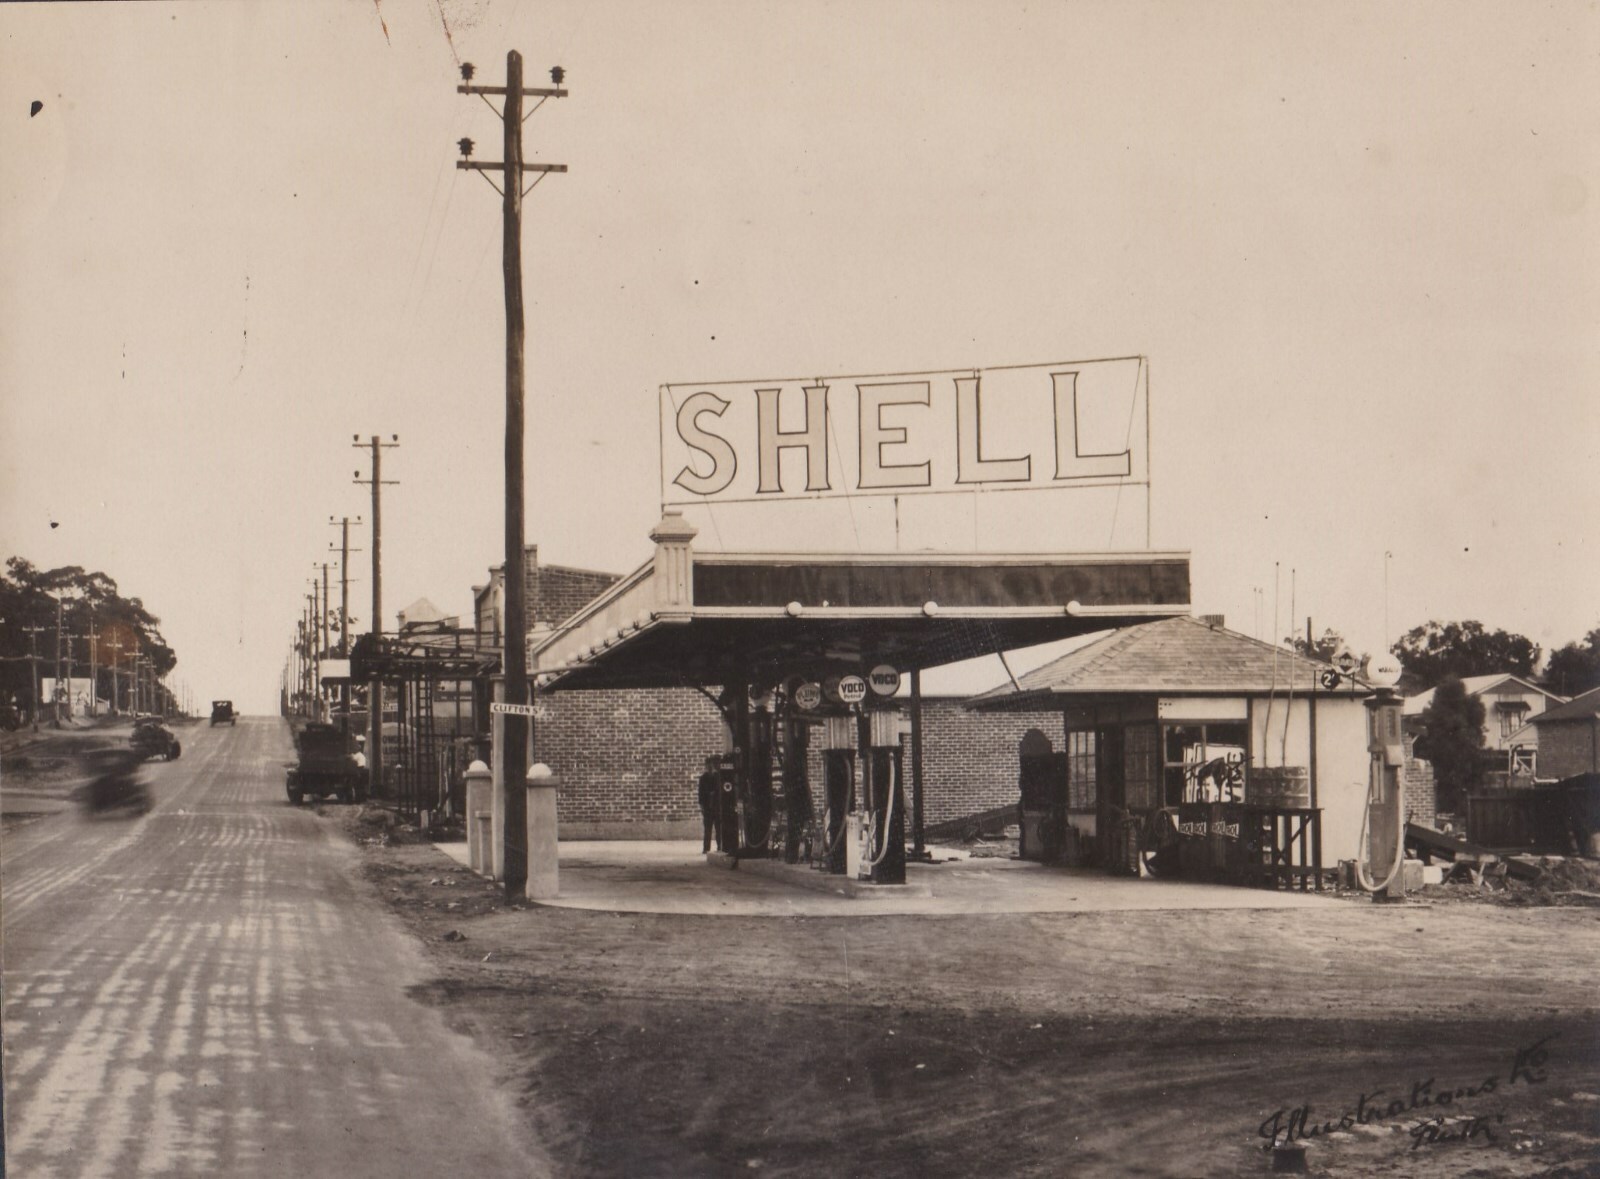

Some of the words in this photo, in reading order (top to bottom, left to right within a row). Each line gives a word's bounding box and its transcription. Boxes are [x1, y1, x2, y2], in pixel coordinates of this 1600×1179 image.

[673, 372, 1131, 495] SHELL
[871, 673, 897, 685] VOCO
[841, 683, 864, 693] VOCO
[494, 705, 530, 714] CLIFTON
